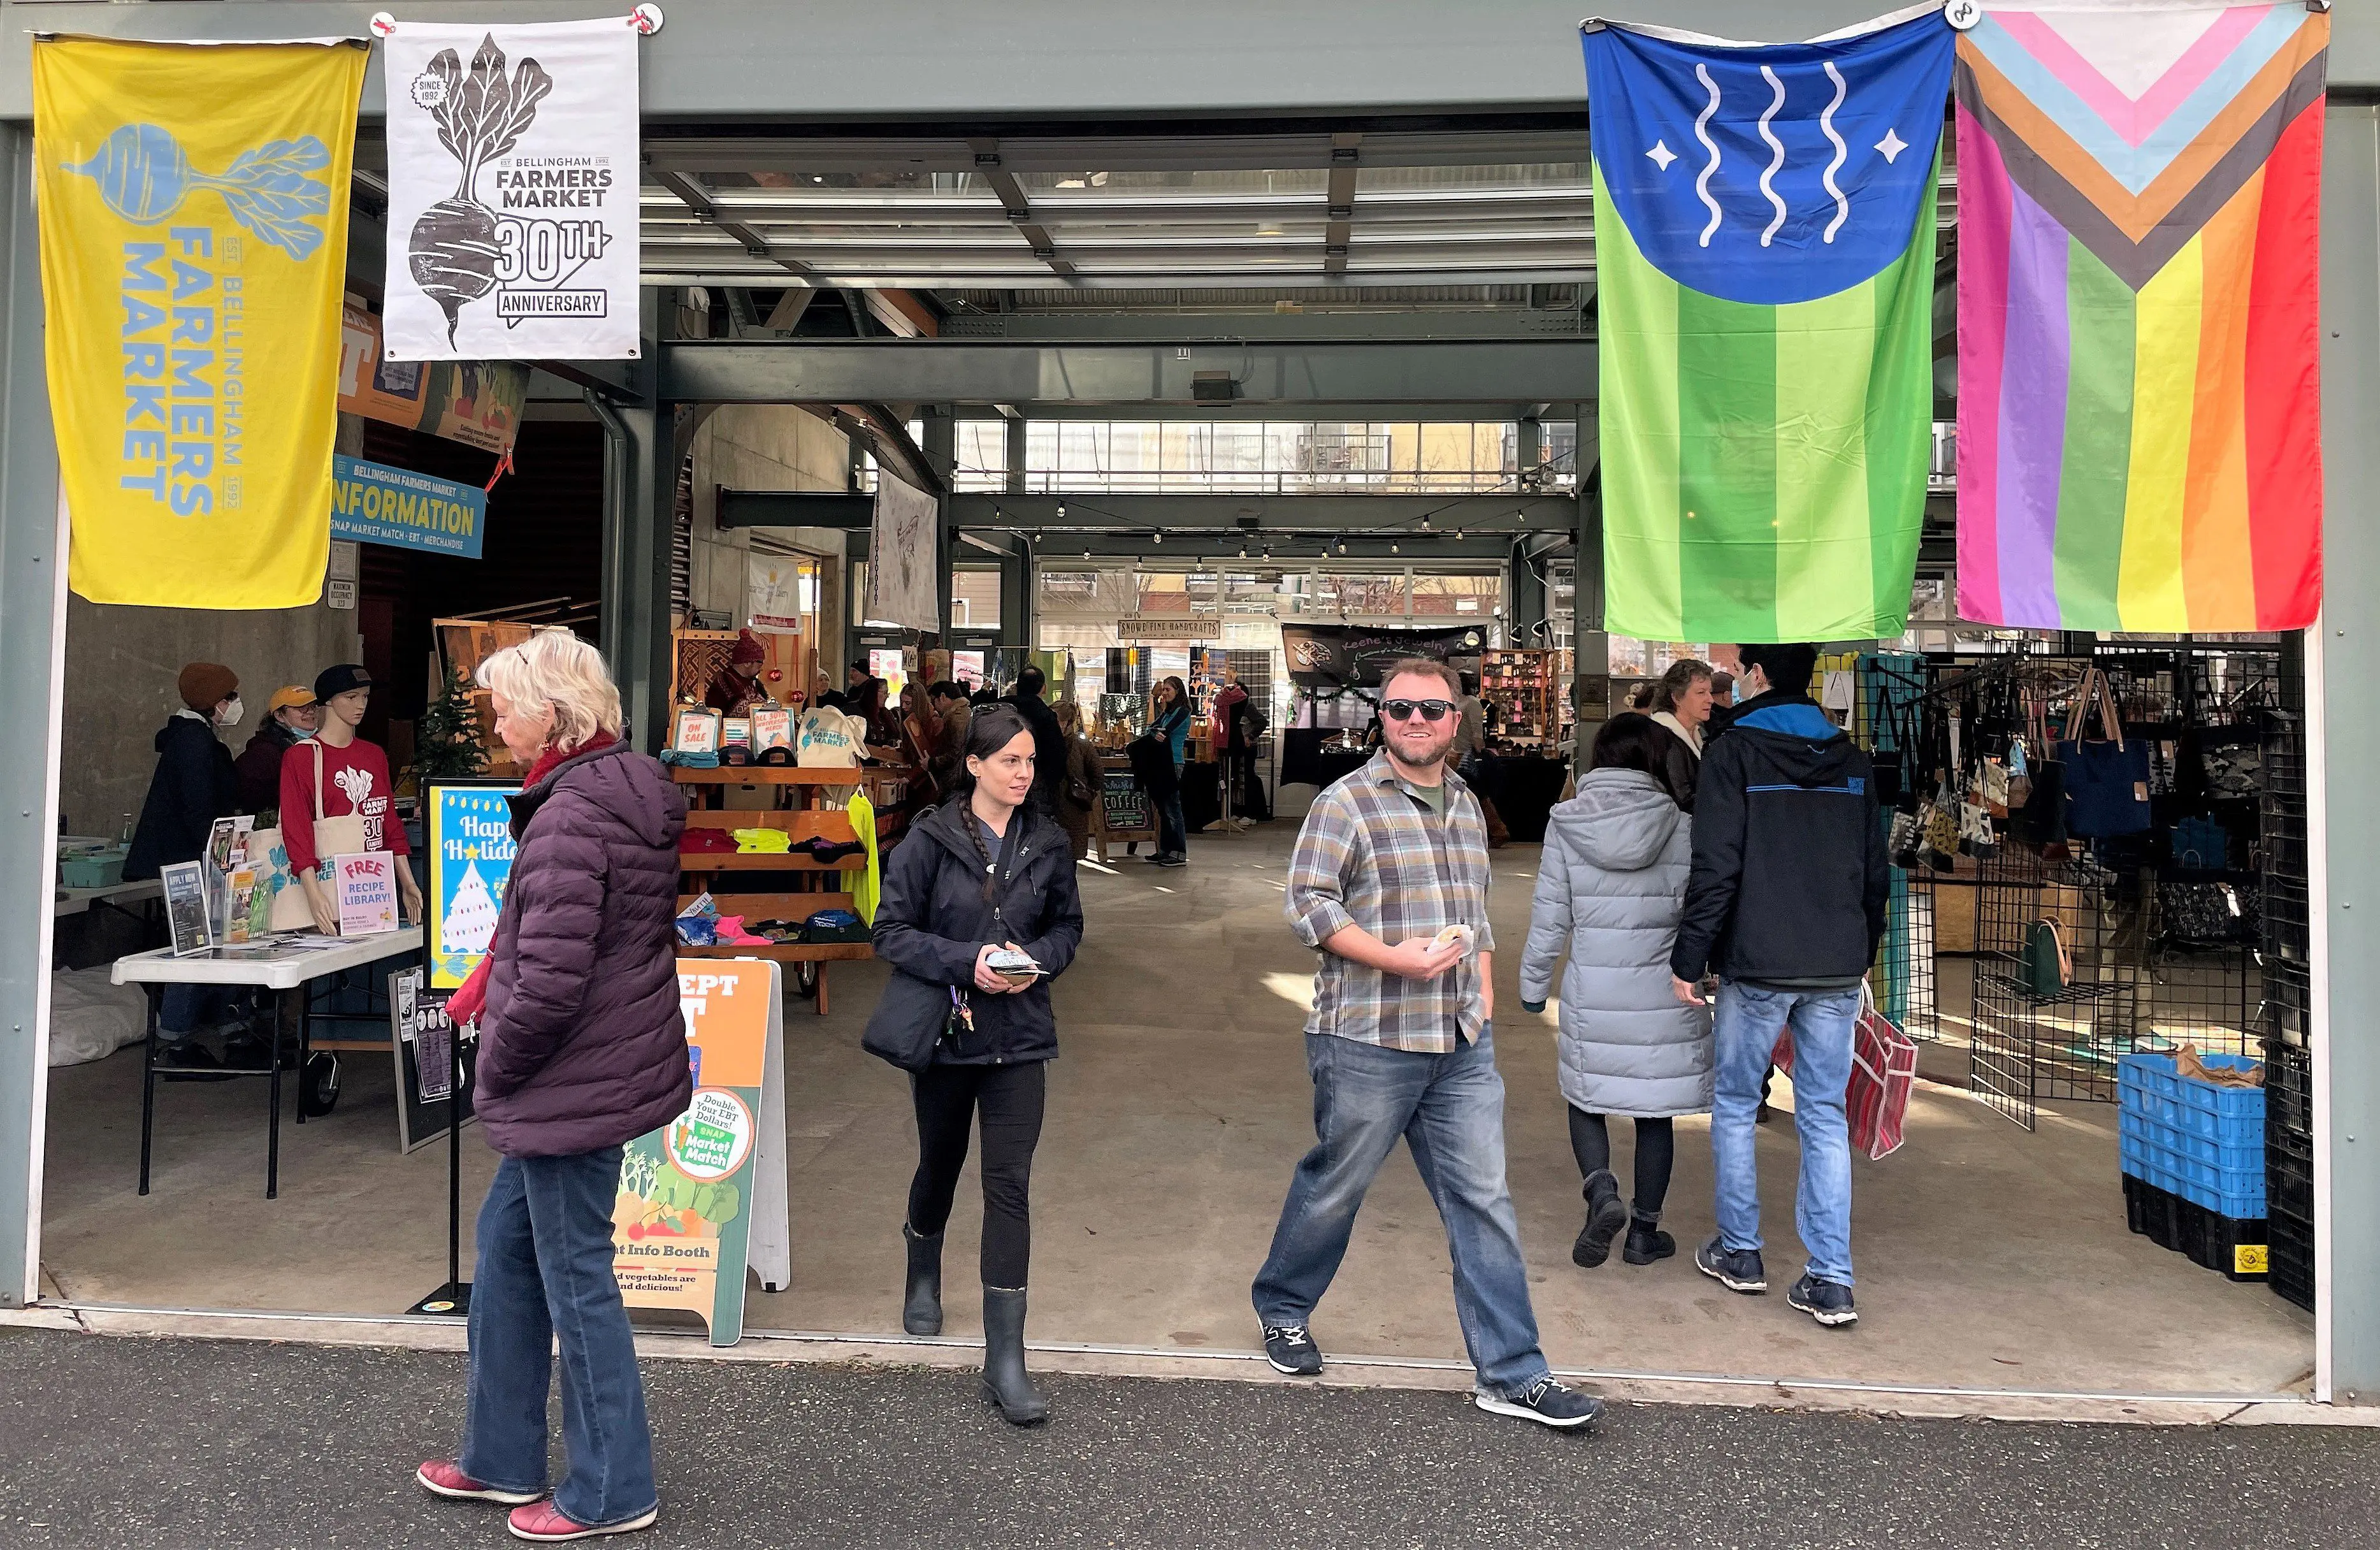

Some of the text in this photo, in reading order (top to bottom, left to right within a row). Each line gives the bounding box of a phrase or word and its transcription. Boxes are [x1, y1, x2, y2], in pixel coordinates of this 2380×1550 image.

[419, 81, 441, 90] SINCE
[422, 91, 438, 100] 1992
[516, 157, 591, 166] BELLINGHAM
[496, 170, 612, 189] FARMERS
[503, 189, 607, 208] MARKET
[493, 219, 603, 282] 30TH
[502, 295, 601, 312] ANNIVERSARY
[120, 242, 168, 502] MARKET
[169, 226, 215, 517] FARMERS
[223, 277, 243, 465] BELLINGHAM
[353, 465, 401, 485] BELLINGHAM
[401, 475, 433, 491] FARMERS
[432, 482, 457, 497] MARKET
[332, 478, 474, 537] NFORMATION
[330, 519, 463, 550] SNAP MARKET MATCH EBT MERCHANDISE
[684, 732, 707, 742] SALE
[688, 723, 701, 732] ON
[345, 860, 385, 880] FREE
[349, 882, 385, 894] RECIPE
[345, 894, 391, 906] LIBRARY!
[677, 974, 739, 996] EPT
[697, 1101, 739, 1122] Your EBT
[703, 1094, 736, 1112] Double
[695, 1111, 732, 1130] Dollars!
[700, 1127, 726, 1139] SNAP
[686, 1134, 731, 1154] Market
[685, 1147, 726, 1167] Match
[628, 1244, 660, 1256] Info
[663, 1245, 710, 1257] Booth
